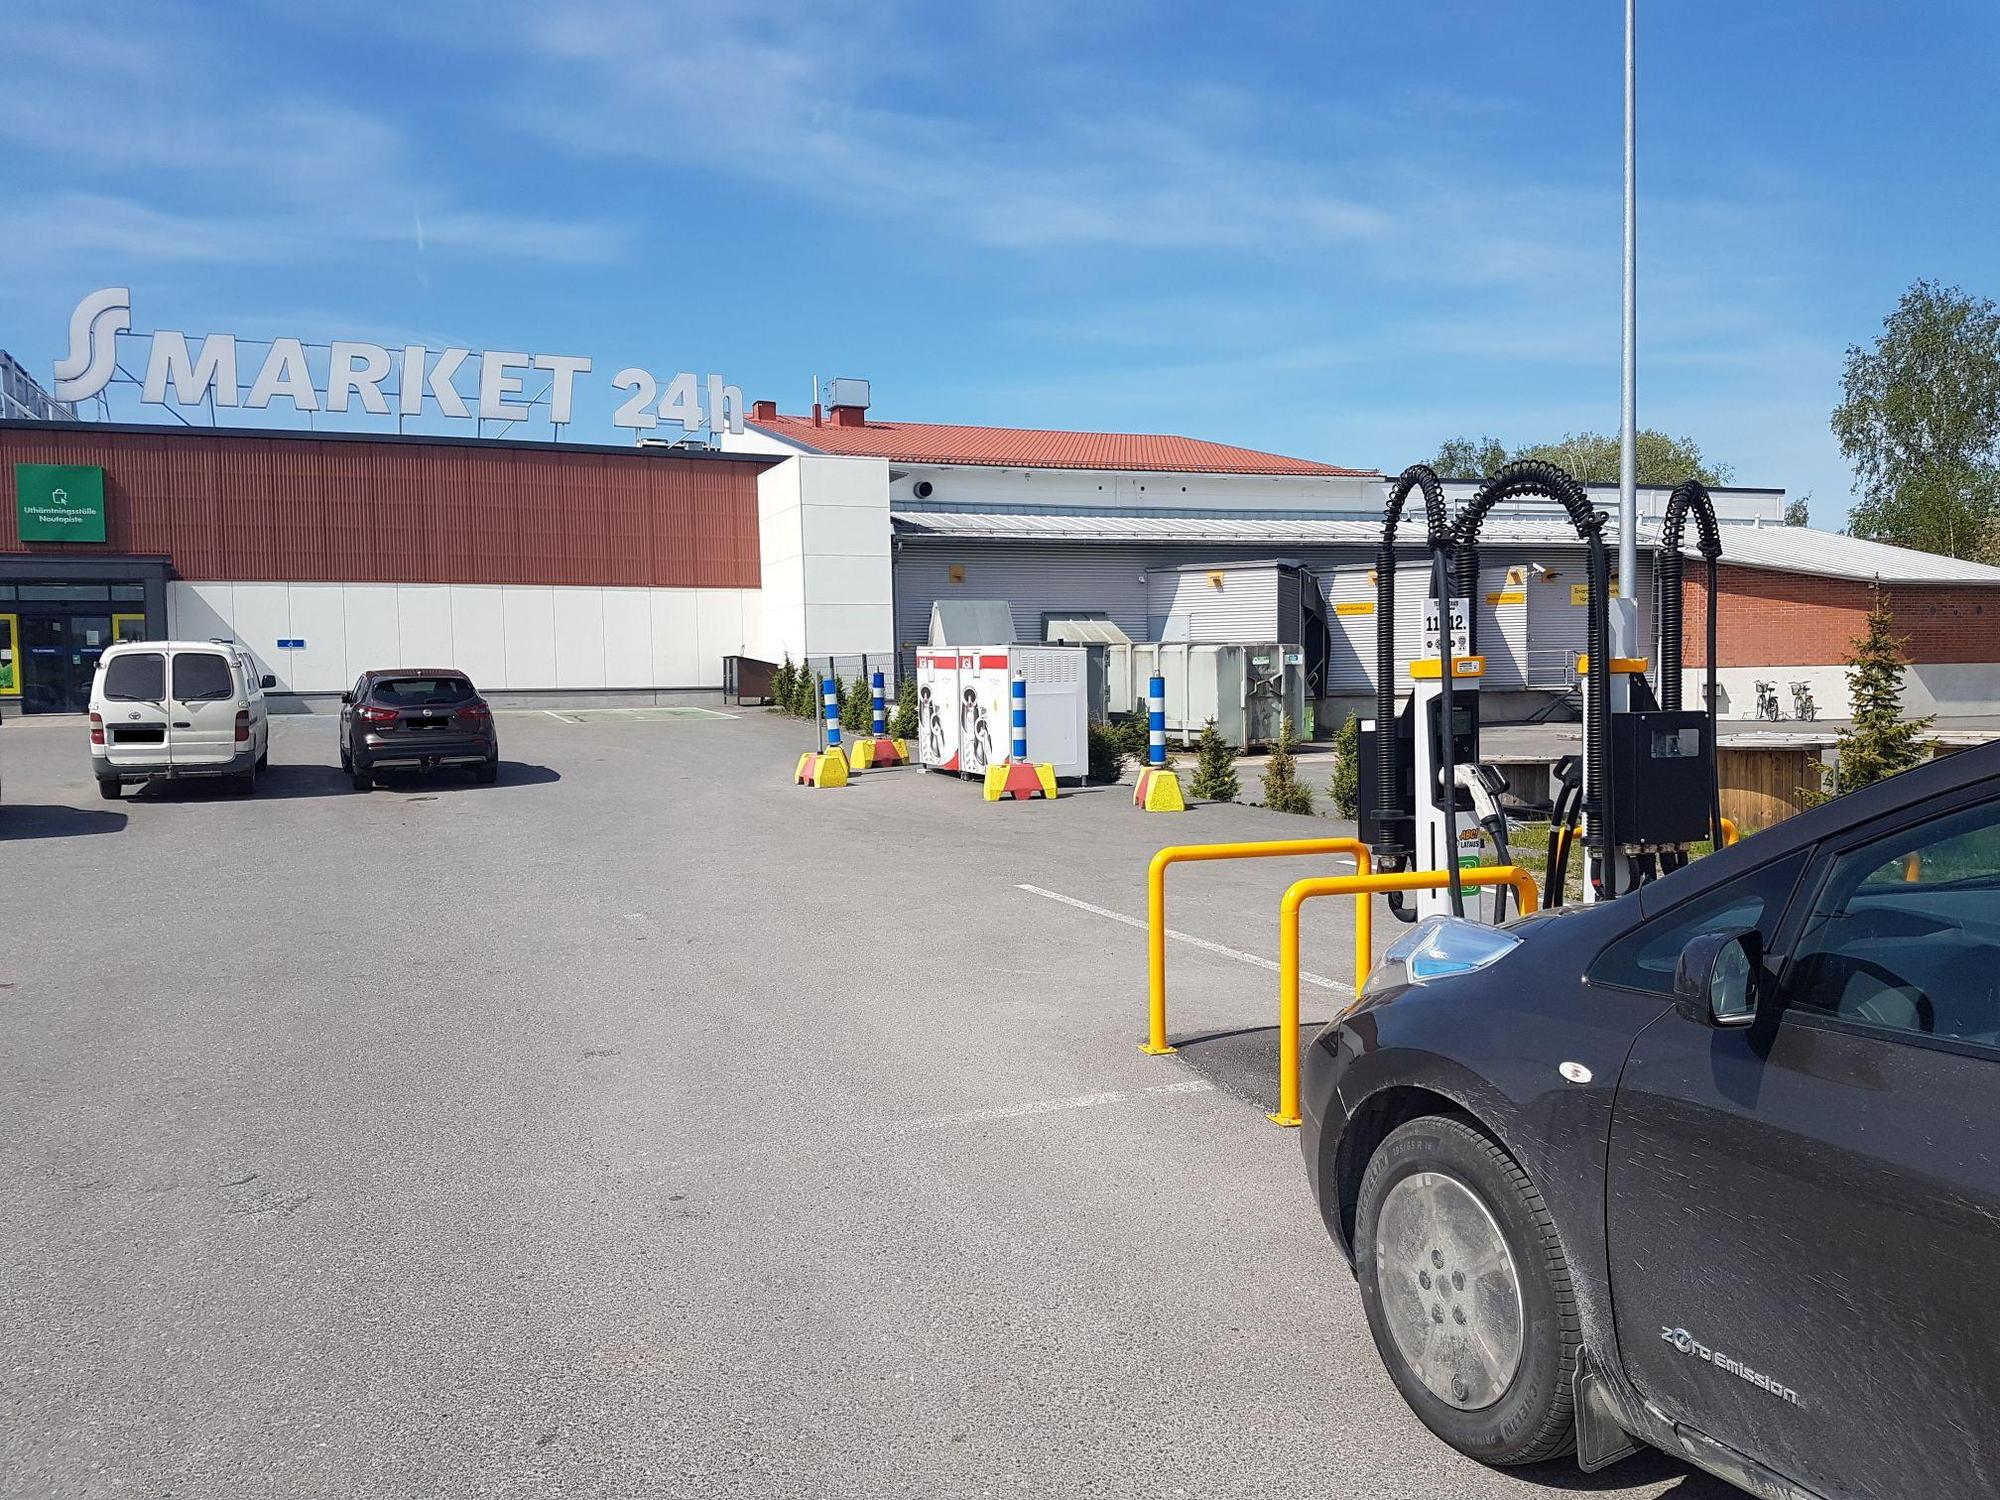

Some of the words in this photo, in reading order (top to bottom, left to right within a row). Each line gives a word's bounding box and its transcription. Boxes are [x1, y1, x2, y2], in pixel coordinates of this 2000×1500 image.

[140, 329, 593, 424] MARKET
[611, 367, 745, 435] 24h
[24, 507, 96, 516] Uthämtningsställe
[39, 515, 83, 524] Noutopiste
[1460, 841, 1480, 849] LATAUS
